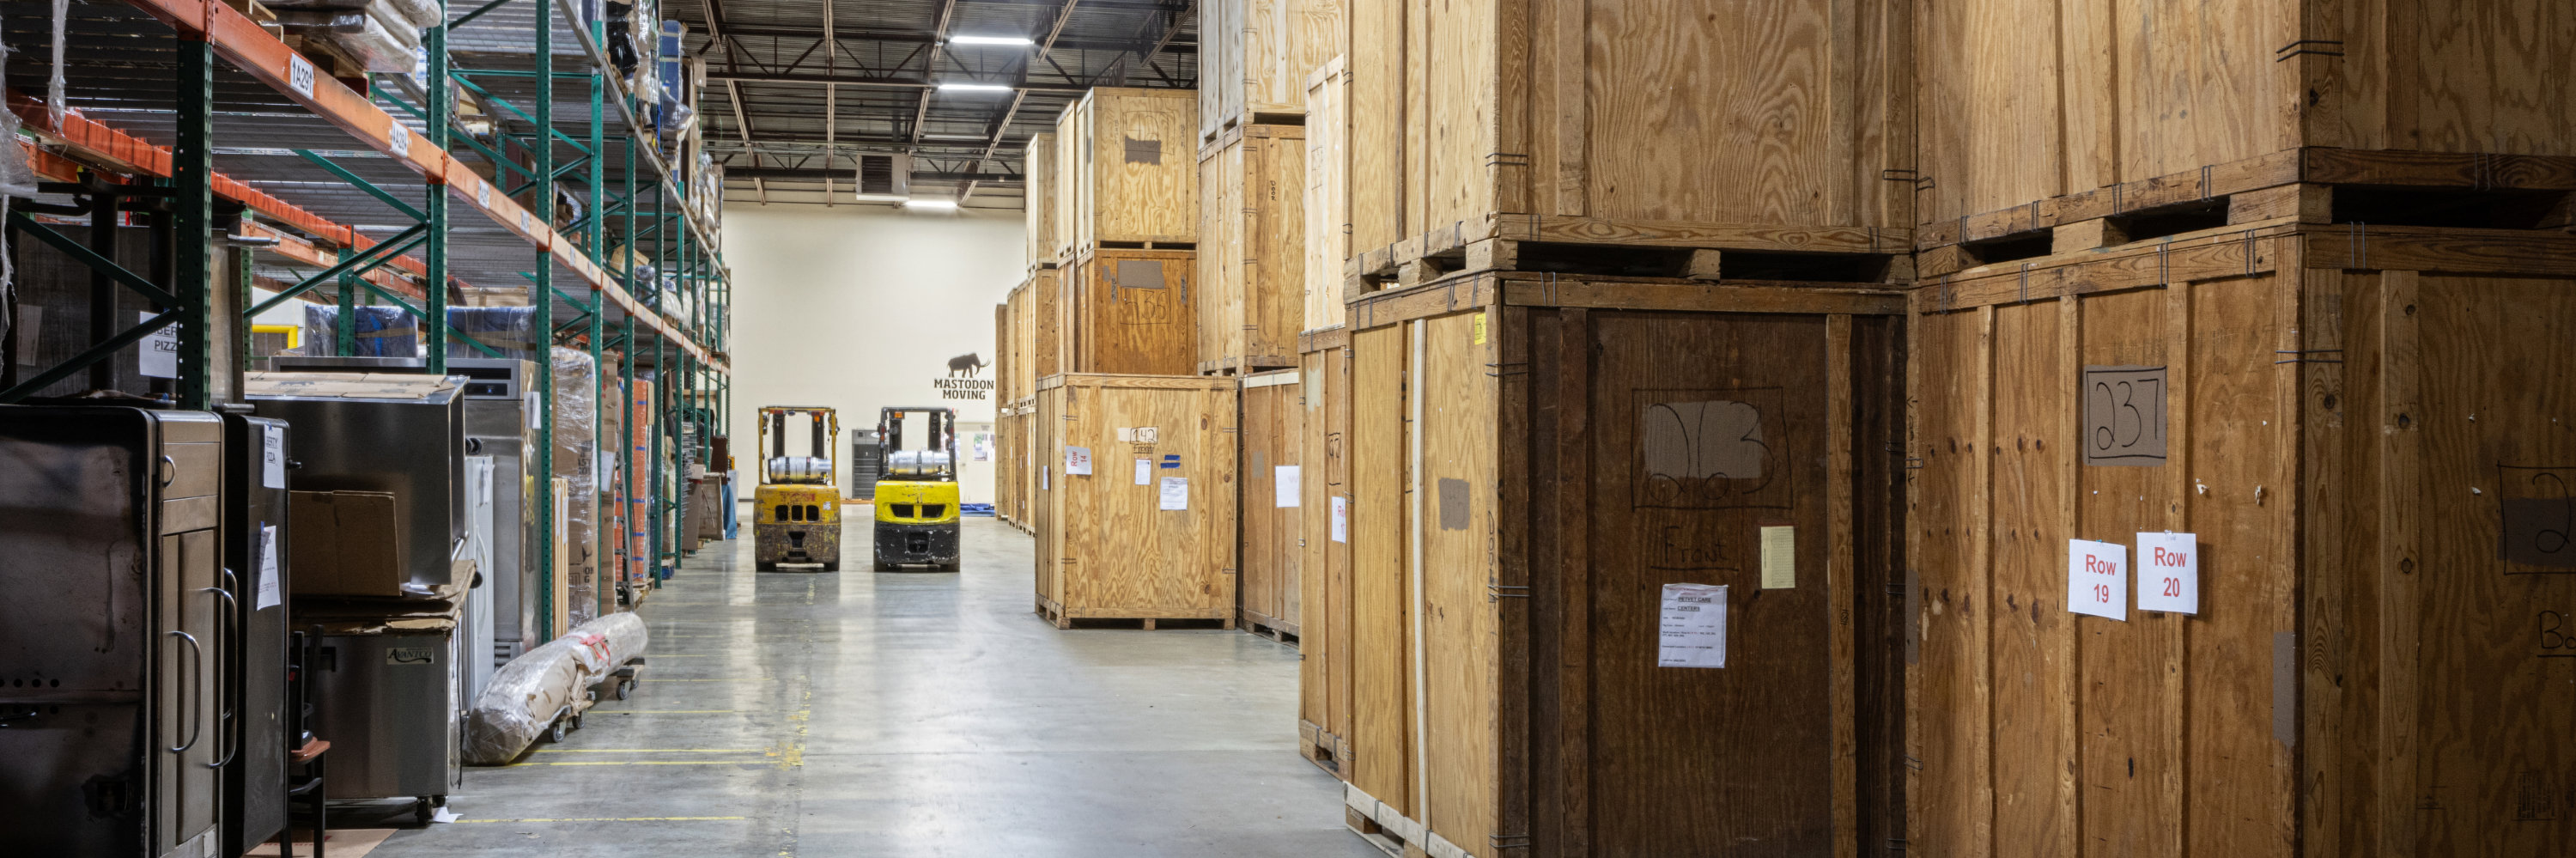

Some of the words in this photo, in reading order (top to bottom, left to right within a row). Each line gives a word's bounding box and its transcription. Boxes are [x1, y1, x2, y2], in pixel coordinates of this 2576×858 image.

[155, 340, 178, 351] PIZZ
[933, 379, 994, 390] MASTODON
[943, 389, 986, 400] MOVING
[2096, 378, 2160, 451] 237
[1133, 429, 1156, 443] 142
[1070, 451, 1078, 467] Row
[1080, 454, 1088, 464] 14
[1648, 400, 1776, 503] 263
[2085, 553, 2117, 576] Row
[2154, 546, 2187, 568] Row
[2093, 583, 2109, 604] 19
[2163, 576, 2180, 598] 20
